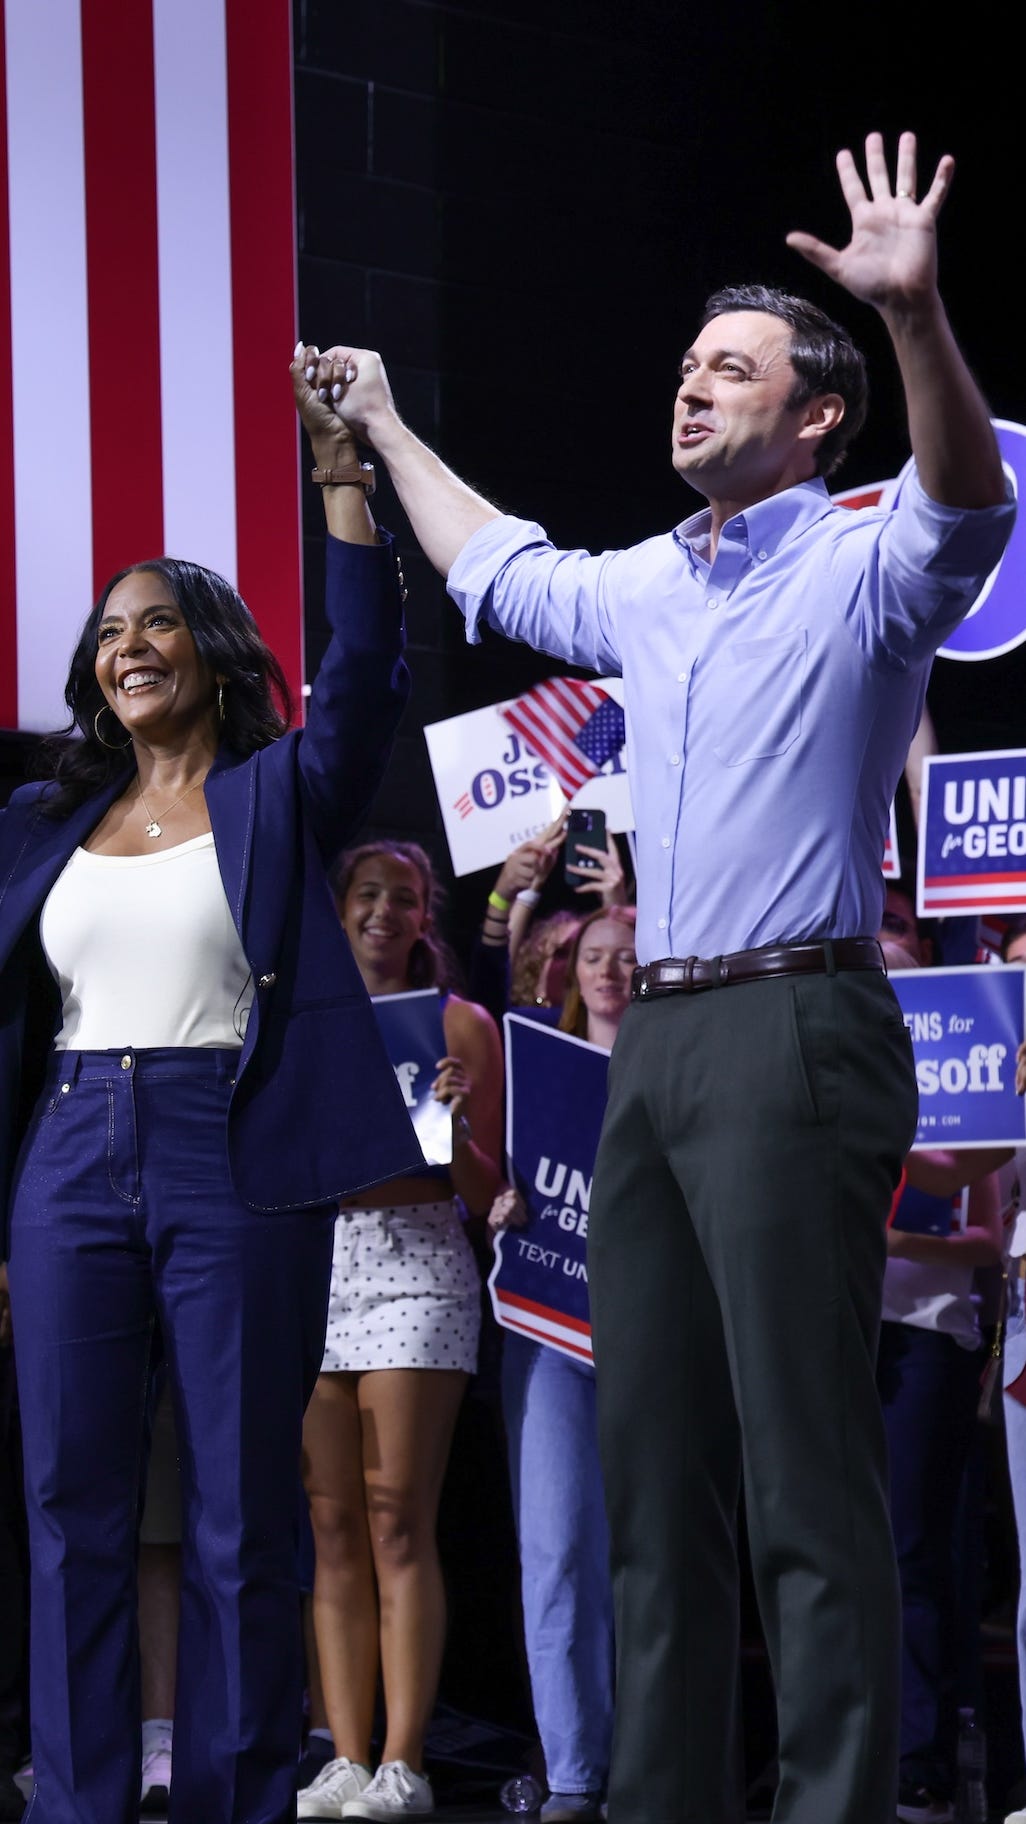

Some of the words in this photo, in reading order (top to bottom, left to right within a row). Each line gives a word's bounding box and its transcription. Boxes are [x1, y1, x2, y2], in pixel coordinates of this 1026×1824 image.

[943, 776, 1026, 825] UNI
[948, 1014, 975, 1034] for
[517, 1239, 561, 1268] TEXT
